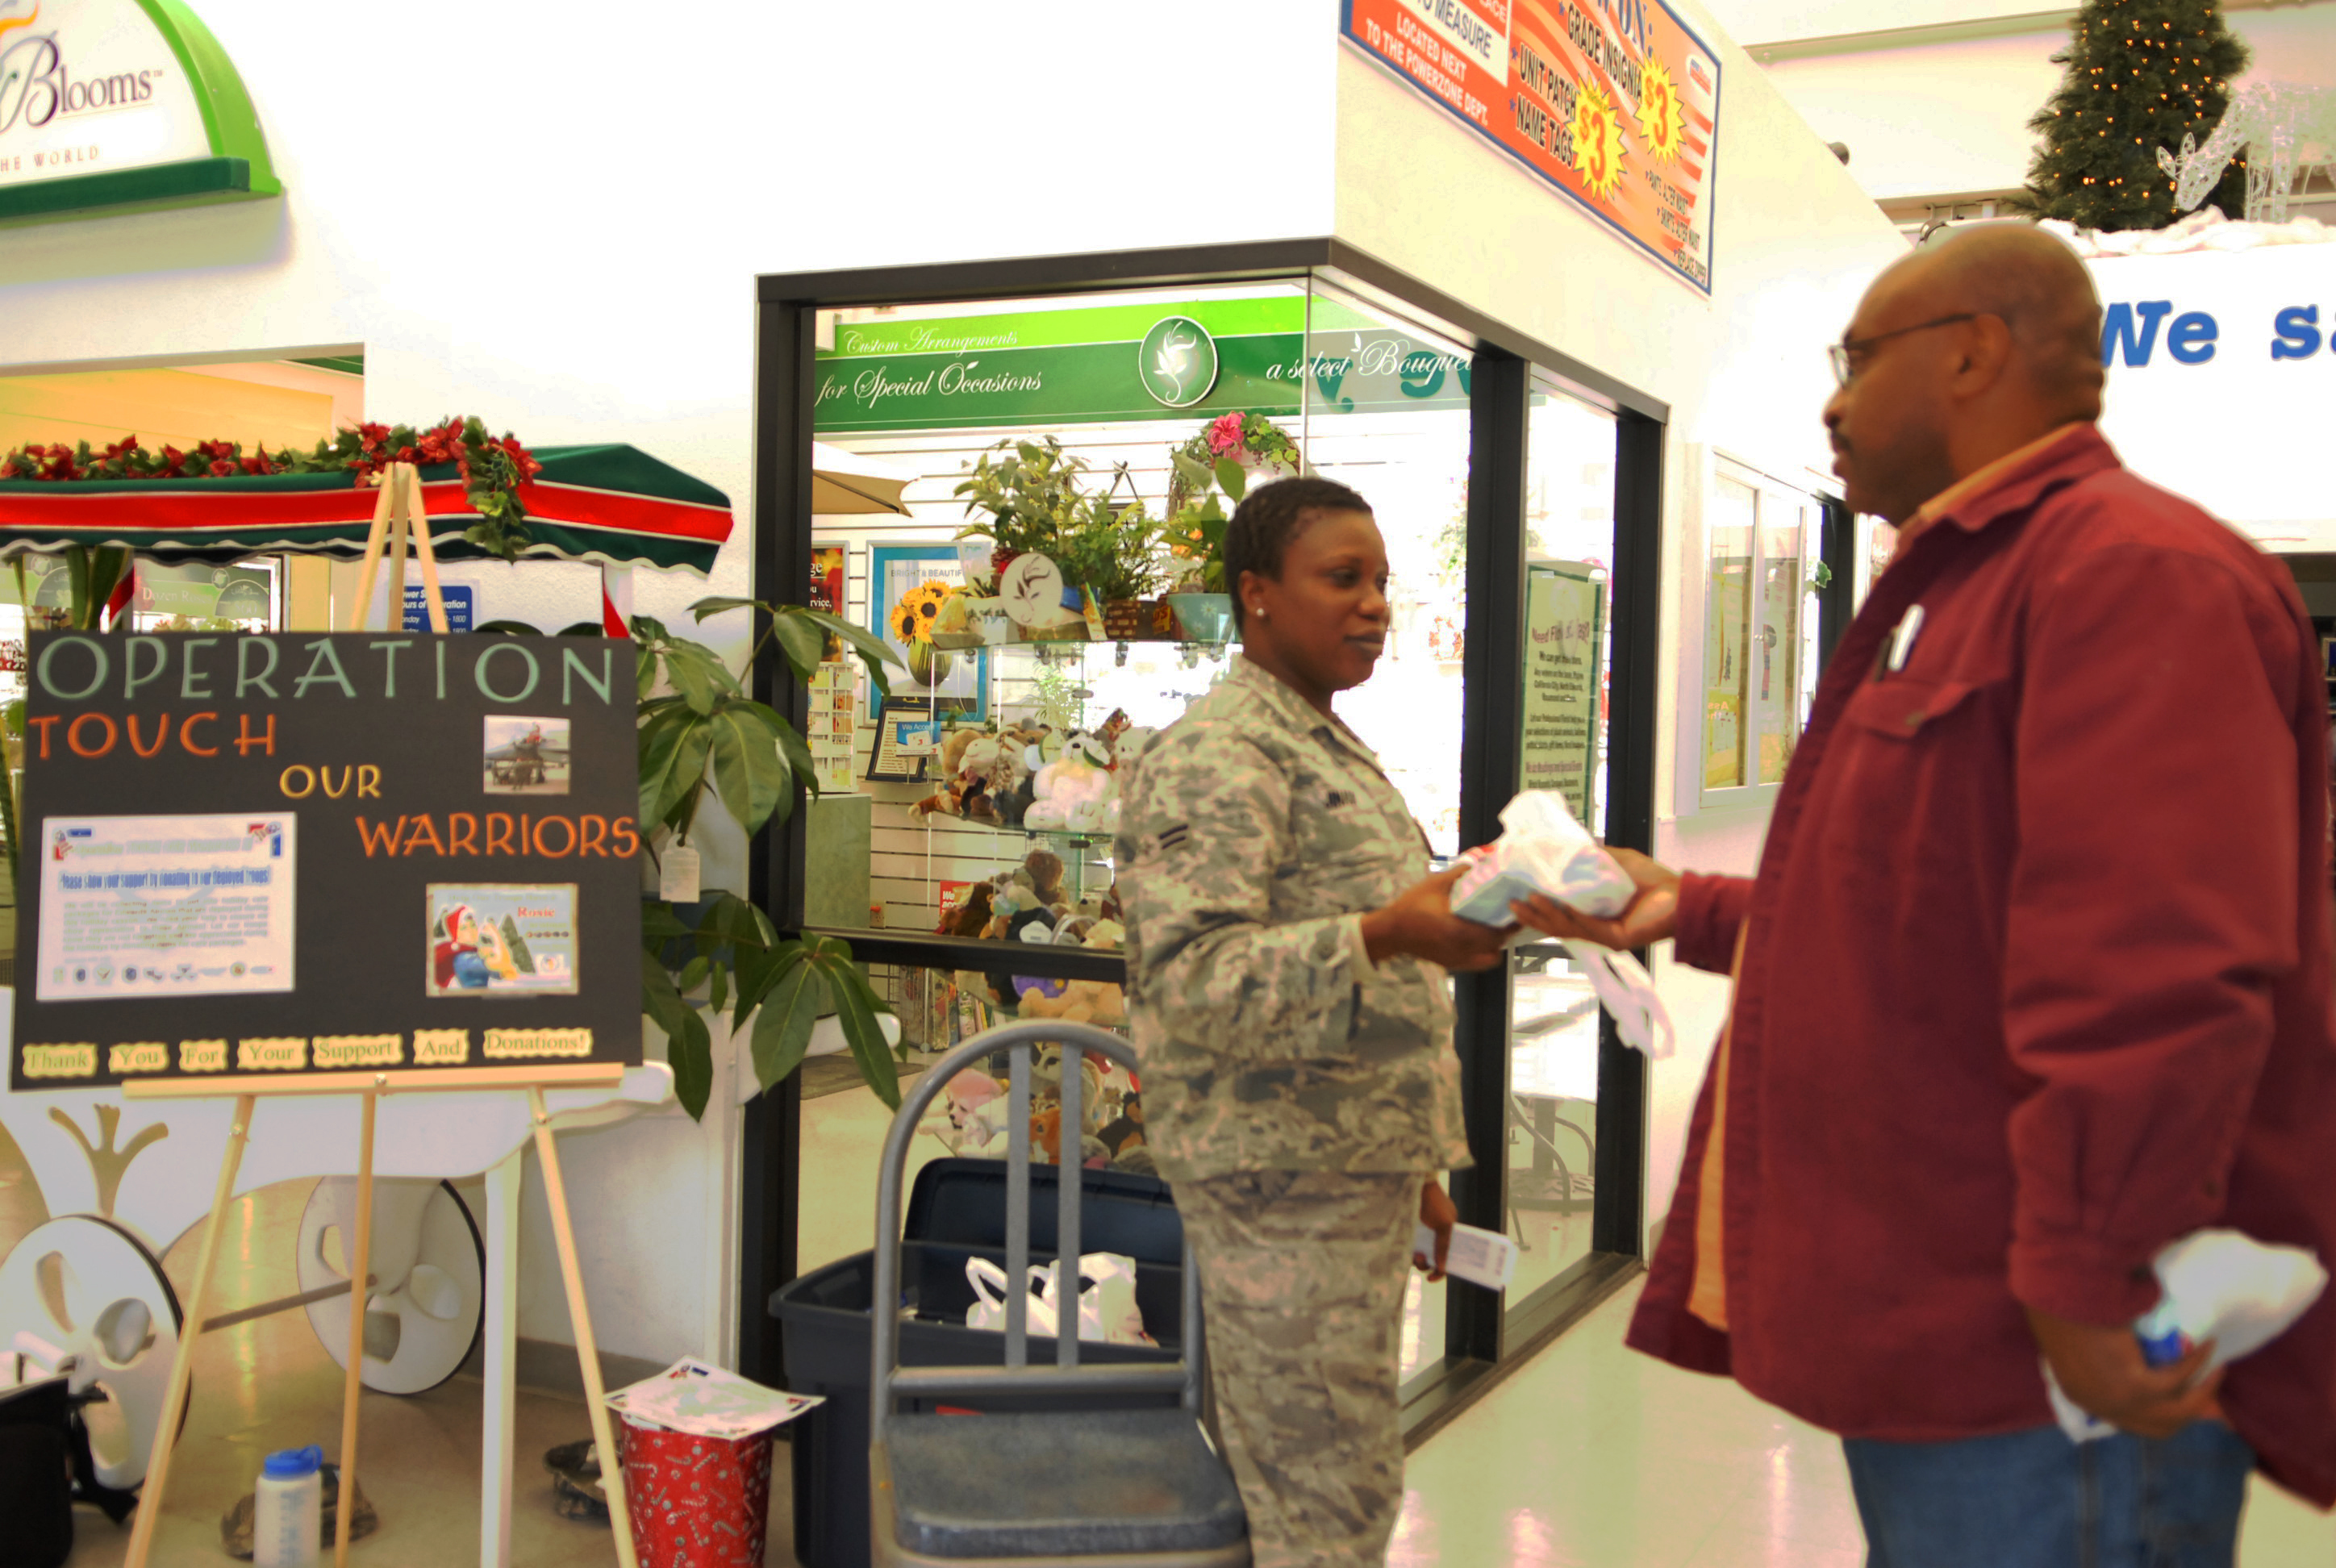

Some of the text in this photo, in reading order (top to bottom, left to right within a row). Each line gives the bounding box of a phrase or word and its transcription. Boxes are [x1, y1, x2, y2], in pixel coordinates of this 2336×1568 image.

[1396, 11, 1467, 81] LOCATED NEXT
[1434, 0, 1491, 59] MEASURE
[1568, 2, 1642, 105] GRADE INSIGNIA
[0, 30, 153, 135] Blooms
[1366, 18, 1381, 46] TO
[1383, 30, 1405, 64] THE
[1406, 48, 1464, 107] POWERZONE
[1520, 42, 1545, 94] UNIT
[1517, 93, 1546, 148] NAME
[1550, 119, 1573, 169] TAGS
[1645, 75, 1668, 148] $3
[0, 146, 99, 172] HE WORLD
[1579, 105, 1606, 182] $3
[844, 326, 1018, 357] Custom Arrangements
[2100, 299, 2336, 368] We s
[814, 362, 1042, 409] for Special Occasions
[1266, 364, 1284, 380] a
[143, 587, 178, 601] Dozen
[928, 569, 962, 577] BEAUTIF
[810, 597, 832, 609] rvice,
[36, 636, 613, 706] OPERATION
[28, 711, 277, 760] TOUCH
[278, 764, 382, 799] OUR
[355, 811, 640, 858] WARRIORS
[31, 1033, 585, 1070] Thank You For Your Support And Donations!
